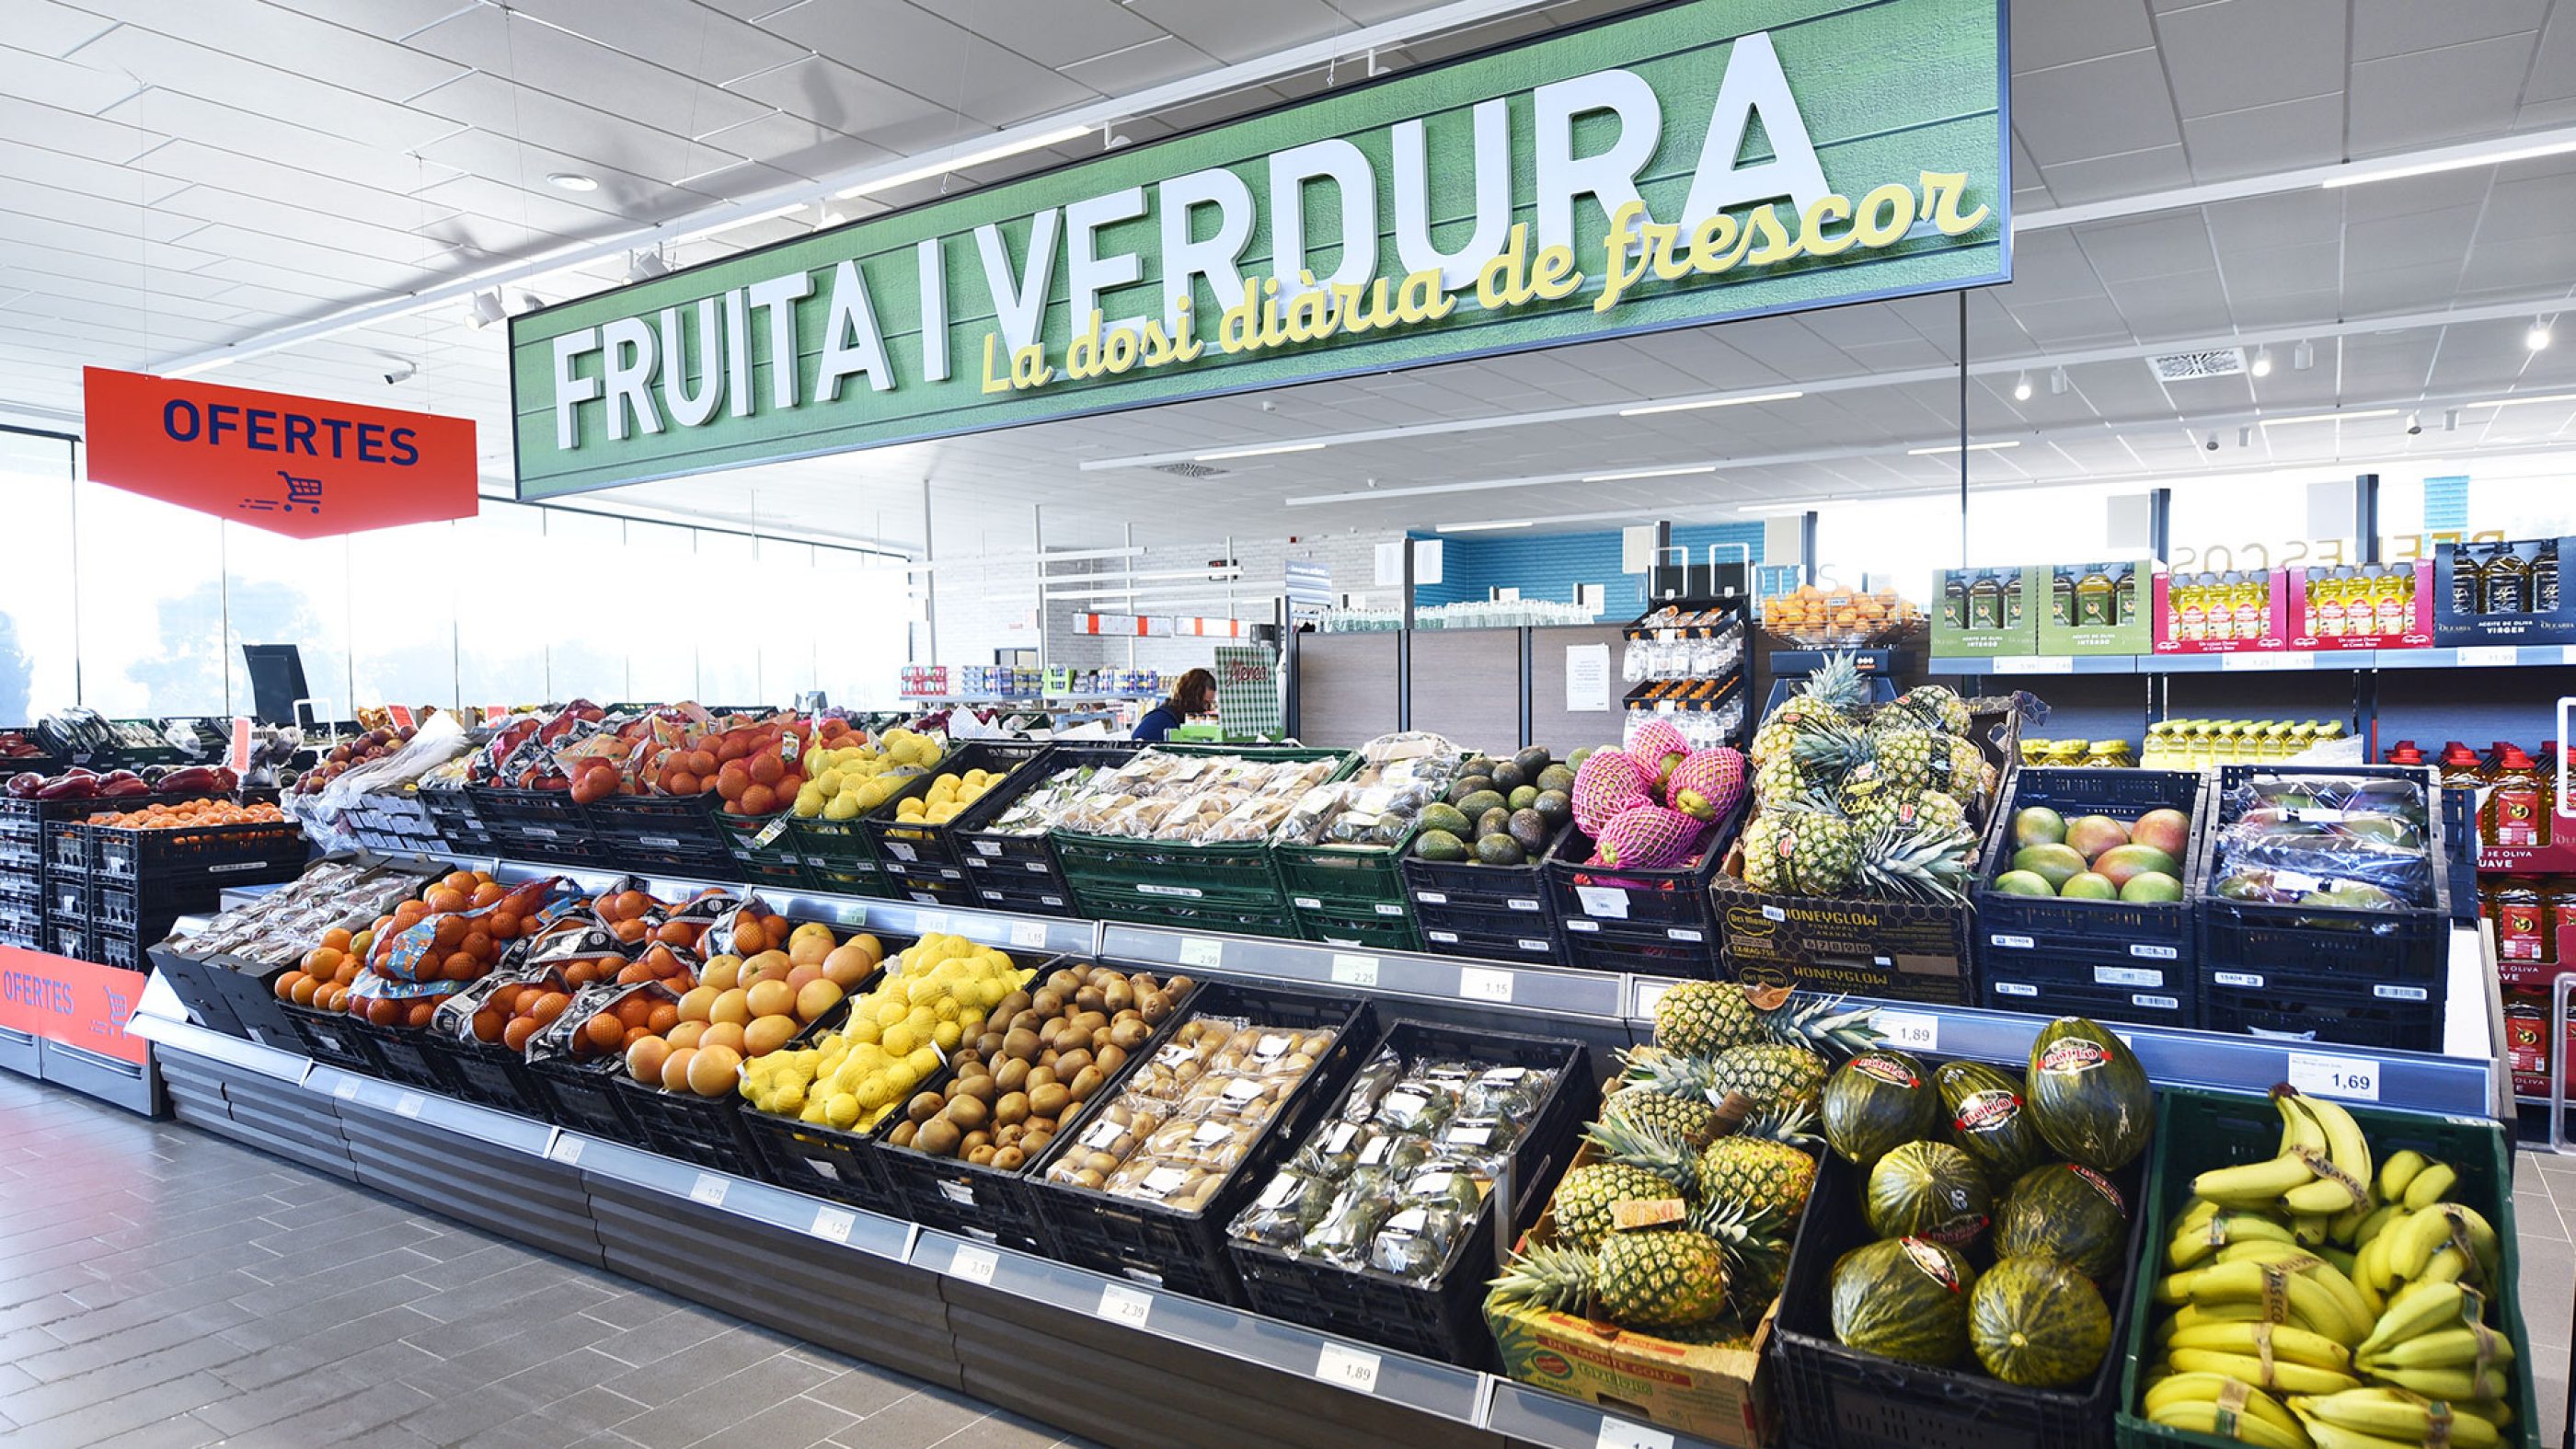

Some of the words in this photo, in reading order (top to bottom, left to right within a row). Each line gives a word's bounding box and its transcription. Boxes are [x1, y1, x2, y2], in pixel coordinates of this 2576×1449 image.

[552, 259, 897, 450] FRUITA
[918, 237, 951, 382] I
[973, 30, 1836, 362] VERDURA
[982, 332, 1055, 394] La
[1065, 295, 1205, 379] dosi
[1478, 223, 1583, 311] de
[1593, 170, 1991, 314] frescor
[164, 398, 420, 466] OFERTES
[2502, 850, 2533, 859] OLIVA
[2478, 860, 2513, 868] UAVE
[1857, 944, 1870, 953] 10
[1792, 966, 1889, 985] HONEYGLOW
[2510, 965, 2539, 973] OLIVA
[3, 970, 75, 1016] OFERTES
[1485, 982, 1508, 995] 1,15
[1901, 1027, 1930, 1042] 1,89
[2332, 1073, 2371, 1091] 1,69
[2514, 1076, 2545, 1086] OLIVA
[1121, 1302, 1145, 1318] 2,39
[1547, 1338, 1572, 1353] DEL
[1577, 1349, 1627, 1369] MONTE
[1632, 1366, 1674, 1381] GOLD
[1346, 1363, 1372, 1381] 1,89
